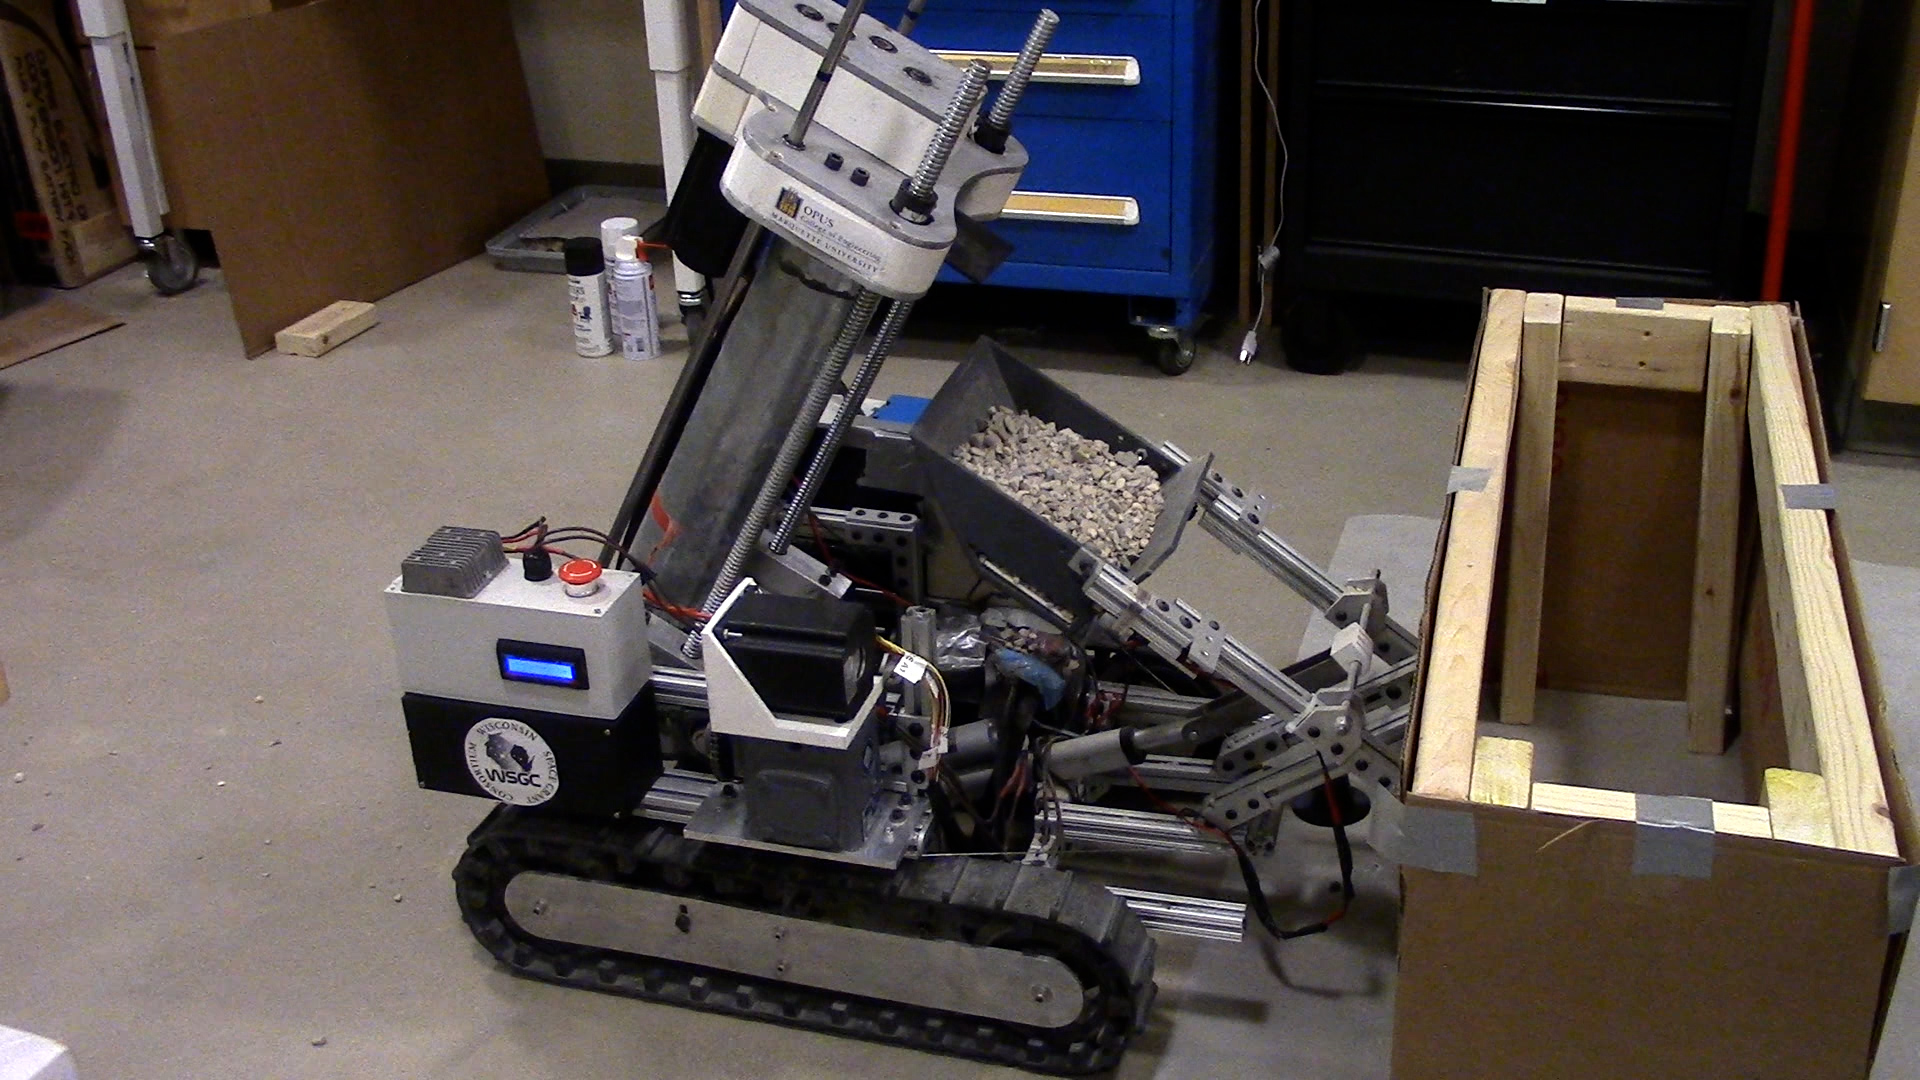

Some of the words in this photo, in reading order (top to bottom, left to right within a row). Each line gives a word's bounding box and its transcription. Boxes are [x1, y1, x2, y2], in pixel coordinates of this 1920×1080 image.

[803, 206, 834, 228] OPUS
[772, 212, 821, 244] MARQUETTE
[825, 243, 877, 272] UNIVERSITY
[800, 215, 826, 233] College
[837, 236, 881, 262] Engineering
[477, 721, 538, 741] WISCONSIN
[484, 768, 541, 787] WSGC
[543, 751, 557, 783] SPACE
[526, 784, 554, 804] GRANT
